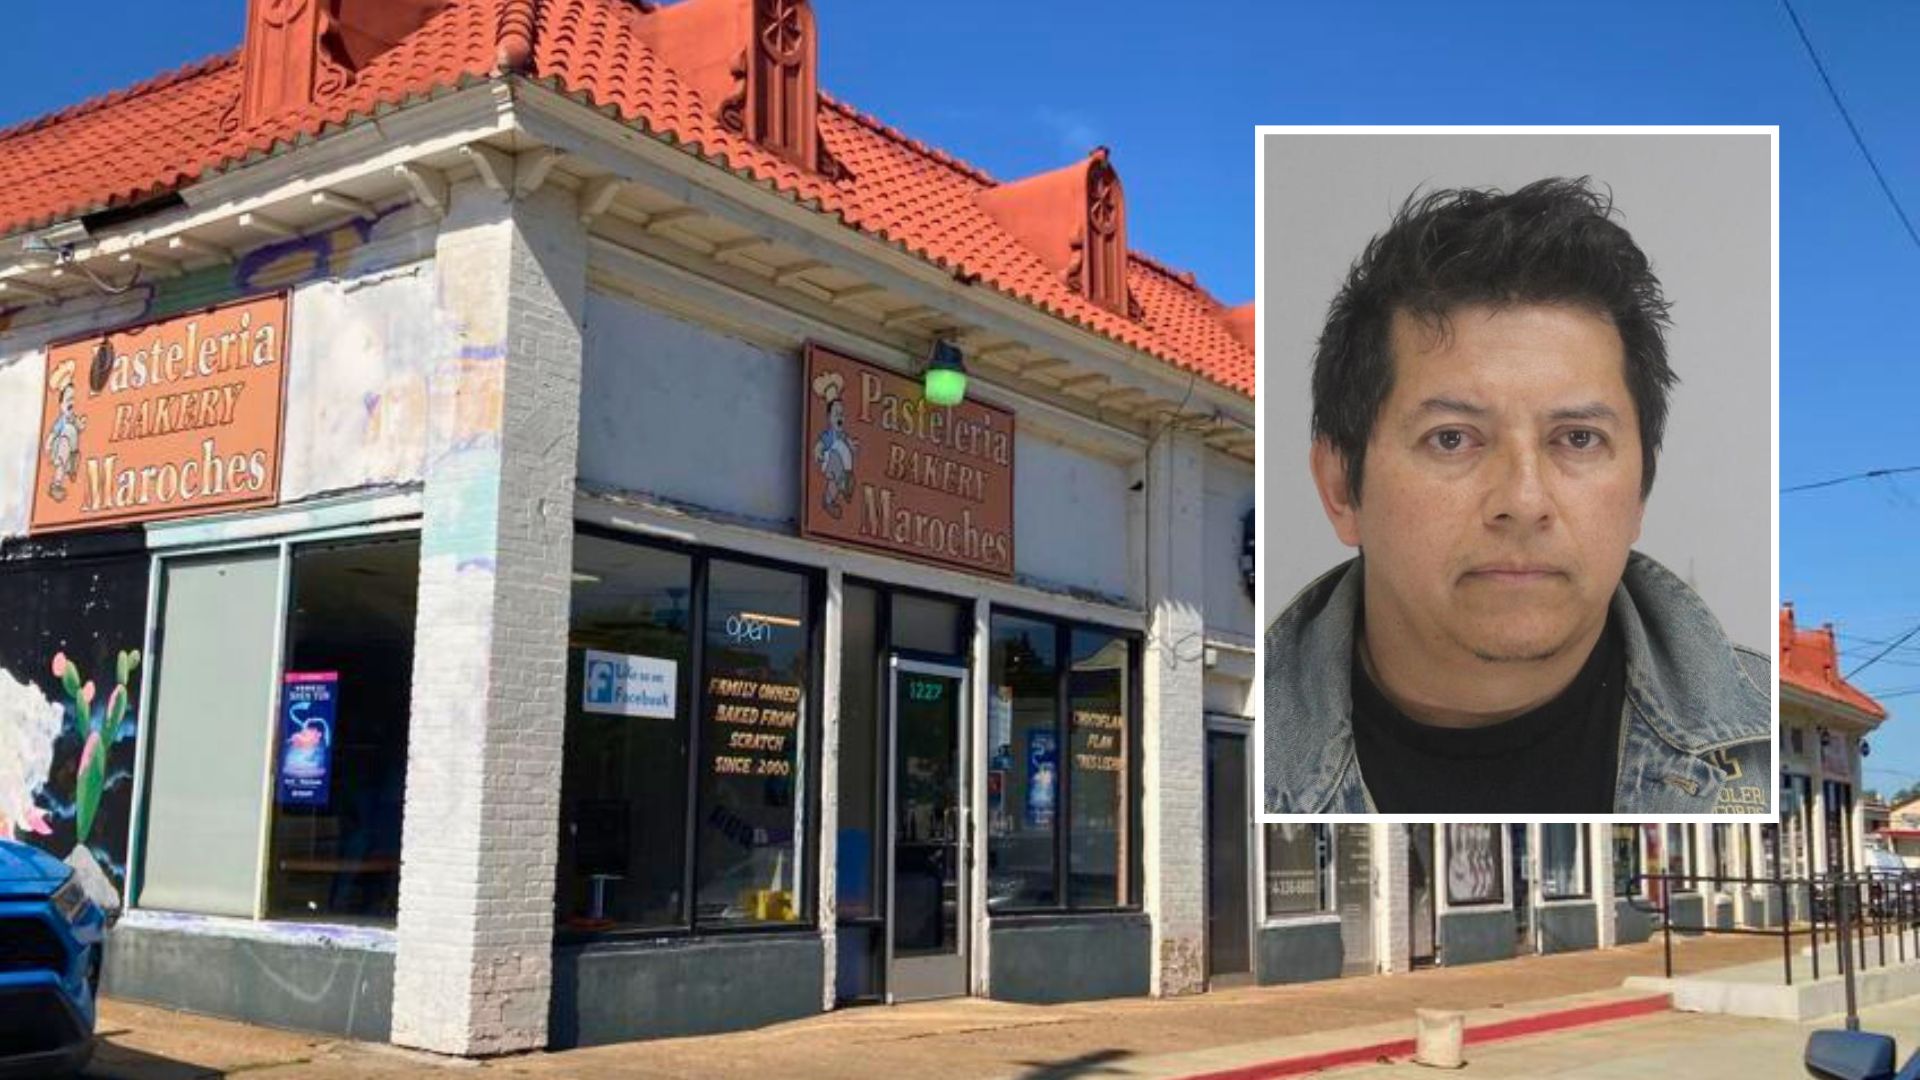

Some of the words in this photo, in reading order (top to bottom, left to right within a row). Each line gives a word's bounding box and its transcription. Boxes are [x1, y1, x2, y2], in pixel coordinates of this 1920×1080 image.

[89, 311, 276, 396] asteleria
[109, 382, 244, 443] BAKERY
[858, 371, 1010, 466] Pasteleria
[81, 438, 267, 512] Maroches
[885, 442, 989, 504] BAKERY
[860, 483, 1009, 560] Maroches
[709, 677, 757, 697] FAMILY
[758, 683, 800, 702] OWNED
[715, 703, 760, 724] BAKED
[760, 709, 797, 727] FROM
[714, 755, 752, 774] SINCE
[757, 759, 790, 776] 2000
[729, 731, 785, 751] SCRATCH
